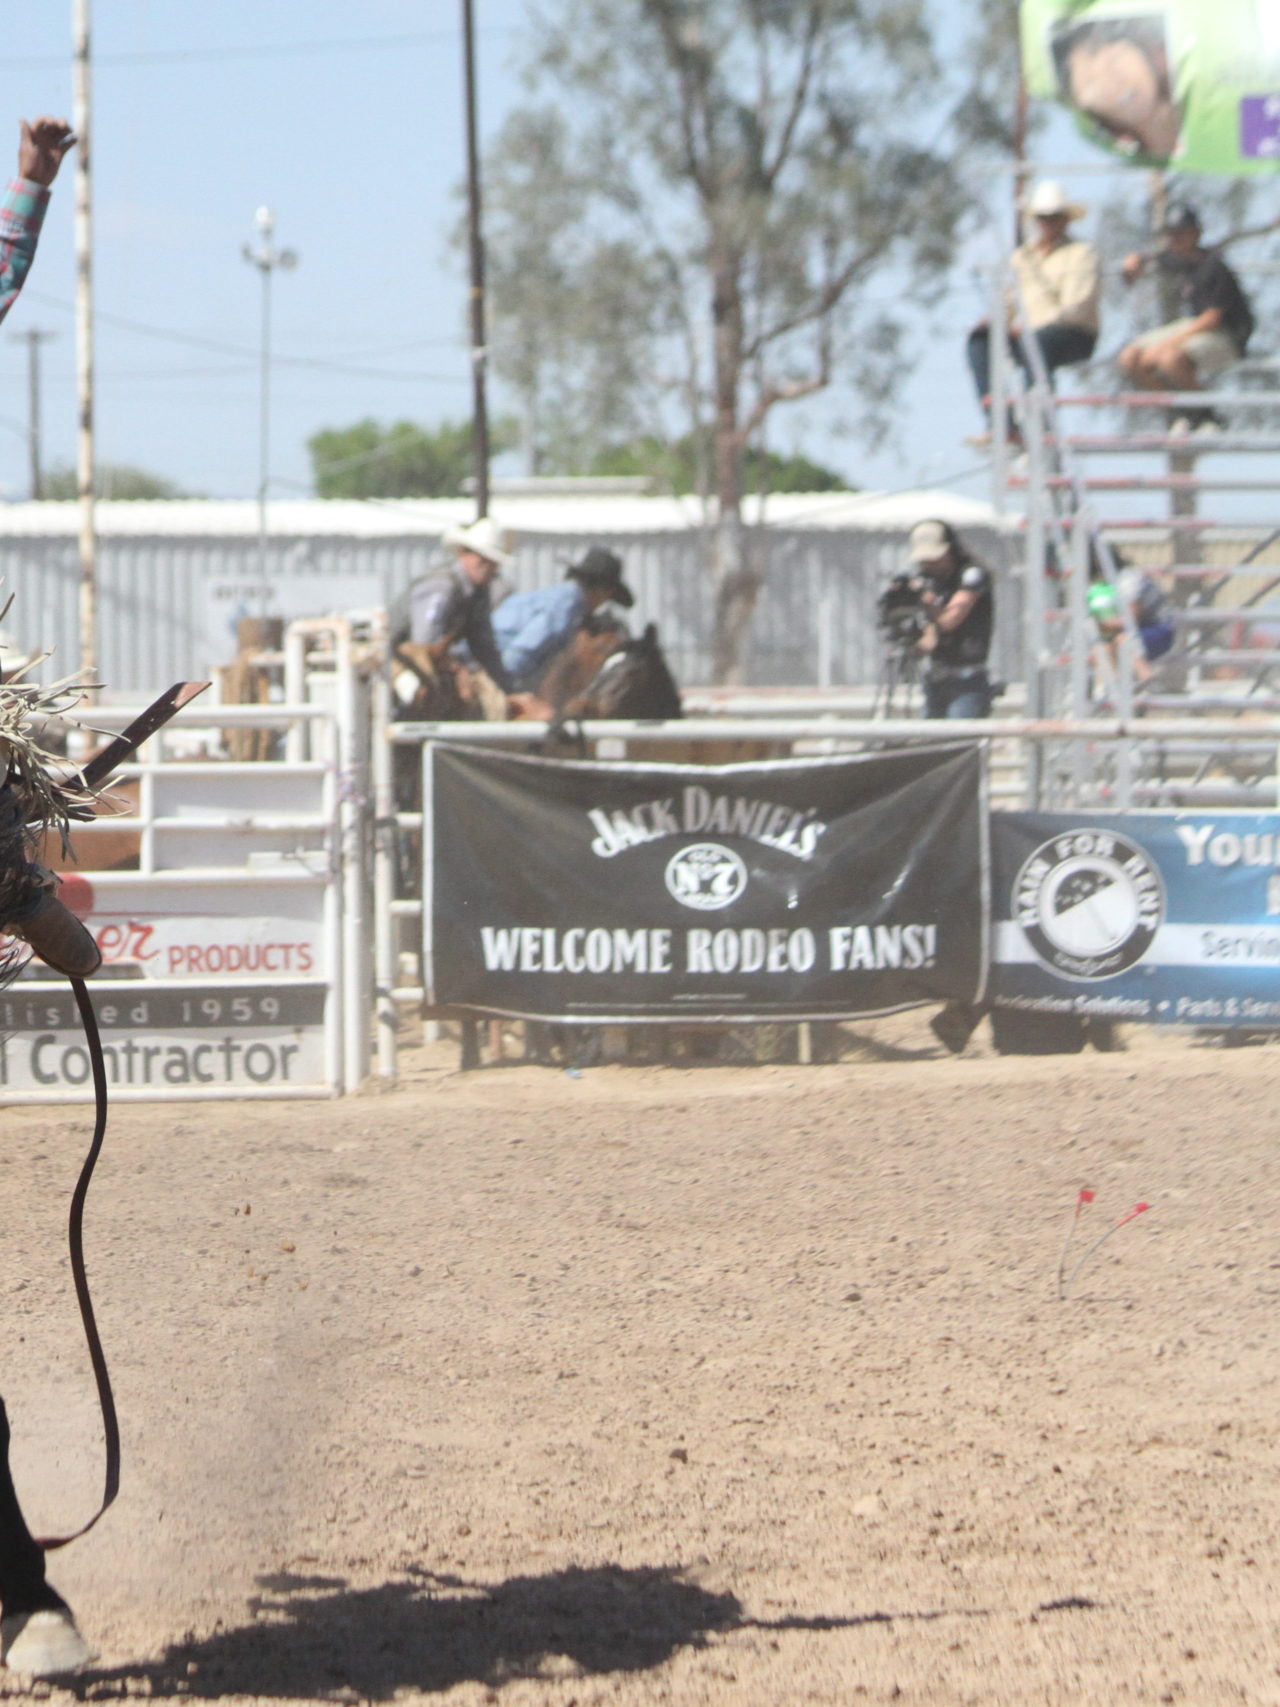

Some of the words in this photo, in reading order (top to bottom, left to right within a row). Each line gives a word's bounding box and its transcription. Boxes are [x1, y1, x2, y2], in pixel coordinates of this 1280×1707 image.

[587, 798, 678, 858] JACK
[682, 785, 828, 861] DANIEL'S
[169, 942, 314, 974] PRODUCTS
[480, 926, 673, 974] WELCOME
[687, 926, 817, 974] RODEO
[828, 924, 937, 972] FANS!
[182, 997, 281, 1024] 1959
[30, 1033, 300, 1086] Contractor
